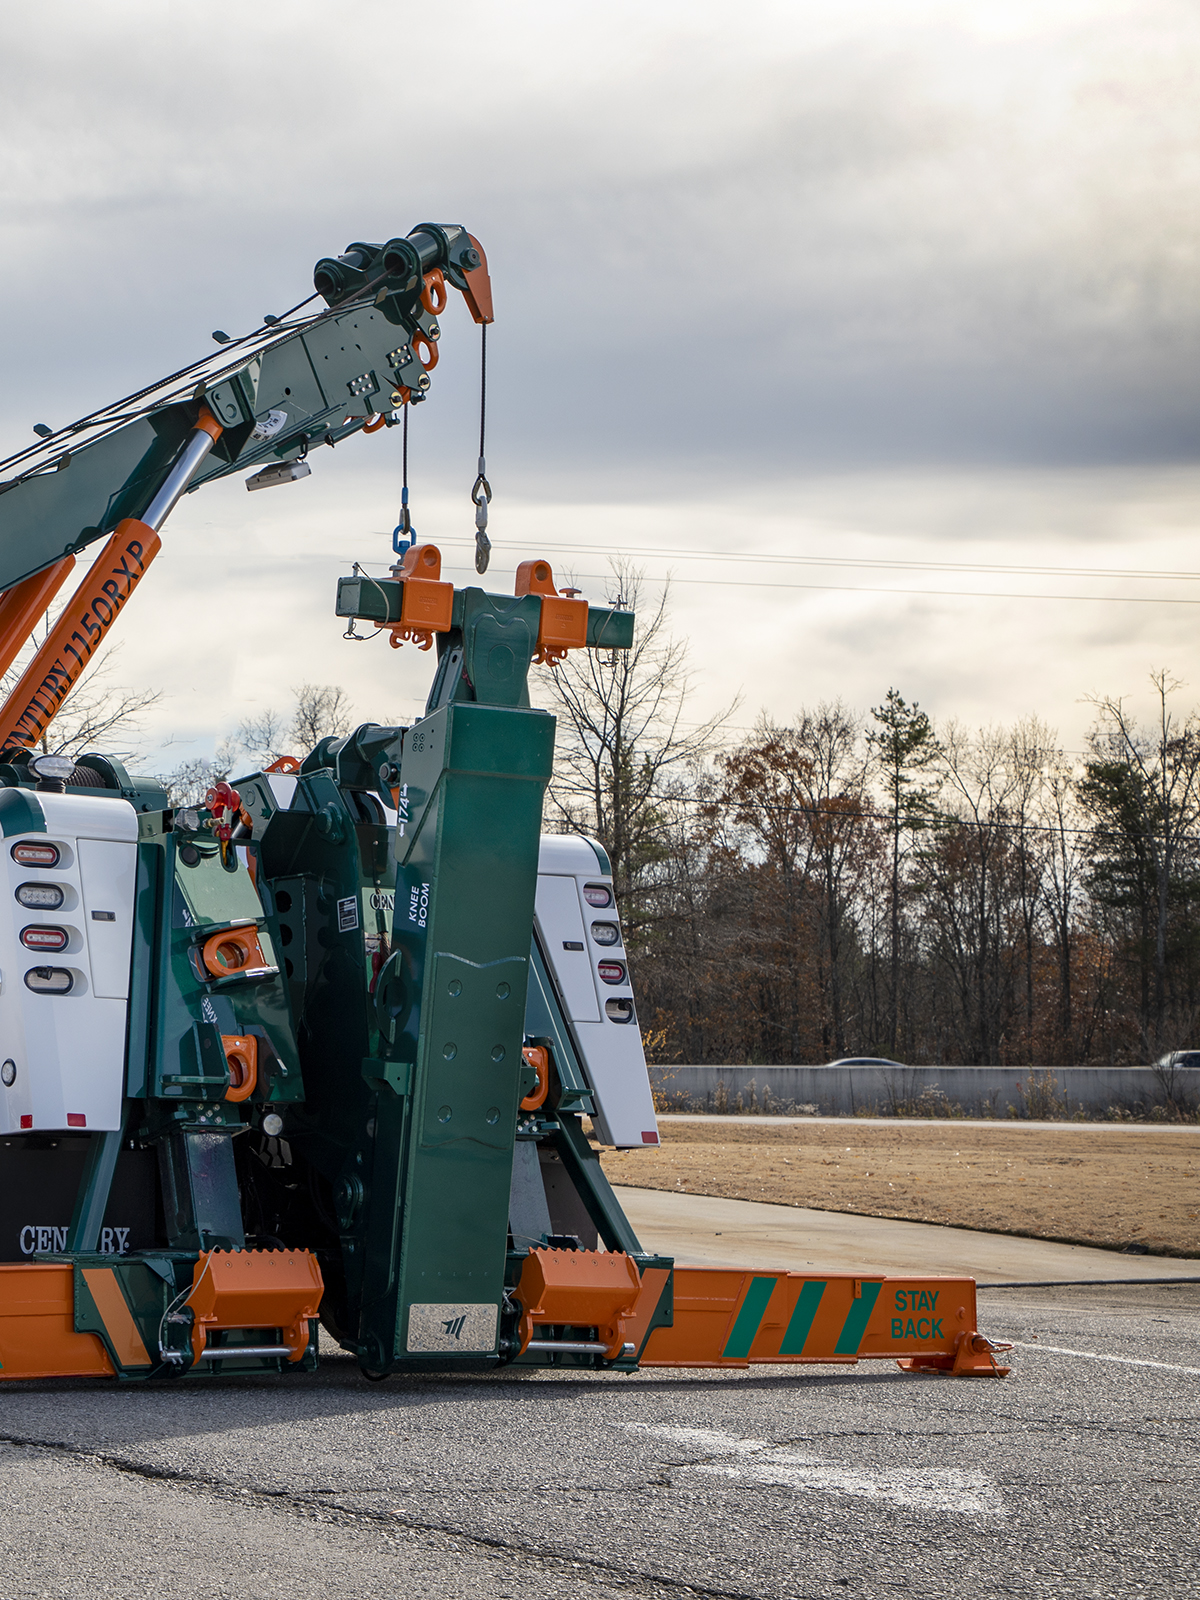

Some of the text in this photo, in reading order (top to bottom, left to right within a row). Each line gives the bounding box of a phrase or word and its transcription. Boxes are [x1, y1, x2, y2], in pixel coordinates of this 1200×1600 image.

[63, 540, 144, 668] 1150RXP
[408, 886, 420, 922] KNEE
[418, 883, 430, 928] BOOM
[20, 1225, 130, 1254] CENRY
[894, 1289, 940, 1312] STAY
[891, 1317, 945, 1340] BACK
